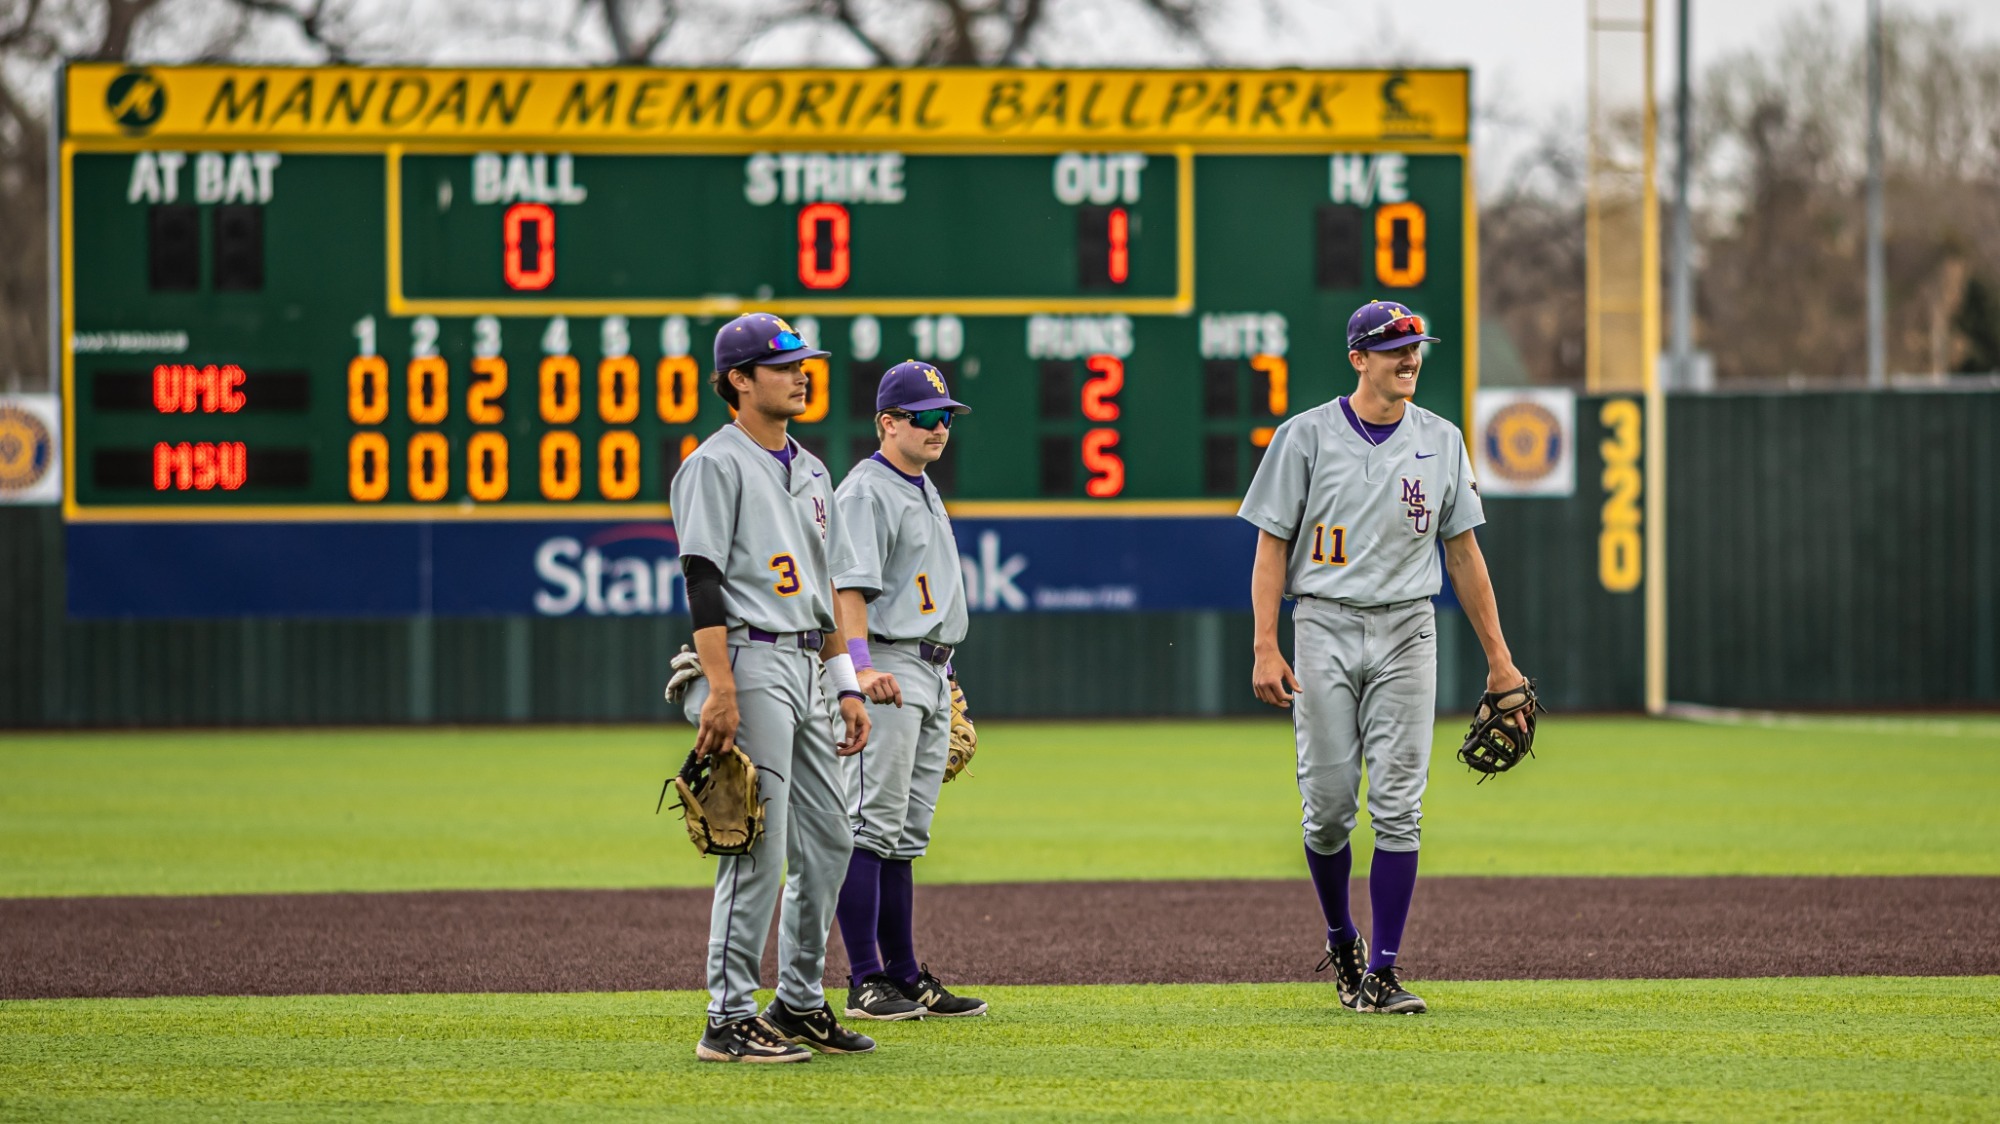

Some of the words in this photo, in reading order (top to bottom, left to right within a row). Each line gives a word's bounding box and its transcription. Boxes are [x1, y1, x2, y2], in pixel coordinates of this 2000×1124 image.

[203, 76, 534, 126] MANDAN
[554, 78, 946, 130] MEMORIAL
[979, 79, 1346, 130] BALLPARK
[128, 153, 183, 204] AT
[194, 152, 280, 204] BAT
[471, 153, 587, 204] BALL
[745, 153, 906, 203] STRIKE
[1053, 153, 1147, 203] OUT
[1329, 153, 1410, 206] H/E
[504, 202, 556, 291] 0
[799, 202, 851, 288] 0
[1108, 206, 1129, 284] 1
[1374, 201, 1427, 287] 0
[353, 315, 377, 357] 1
[411, 315, 440, 358] 2
[472, 315, 502, 358] 3
[541, 316, 572, 357] 4
[661, 316, 691, 357] 6
[851, 315, 880, 361] 9
[910, 314, 964, 361] 10
[1027, 313, 1134, 359] RUNS
[1200, 313, 1288, 358] HITS
[153, 364, 246, 413] UMC
[348, 355, 389, 424] 0
[407, 355, 448, 424] 0
[467, 355, 508, 424] 2
[539, 355, 580, 423] 0
[598, 355, 640, 423] 0
[657, 354, 698, 423] 0
[1081, 354, 1124, 421] 2
[1251, 354, 1288, 417] 7
[153, 441, 247, 490] MSU
[348, 431, 389, 501] 0
[408, 431, 449, 501] 0
[467, 431, 508, 501] 0
[539, 430, 581, 500] 0
[598, 430, 640, 500] 0
[1081, 428, 1125, 497] 5
[1400, 477, 1432, 535] MSU
[1599, 399, 1642, 592] 320
[1312, 523, 1348, 566] 11
[534, 537, 688, 615] Star
[768, 552, 802, 597] 3
[916, 573, 937, 614] 1
